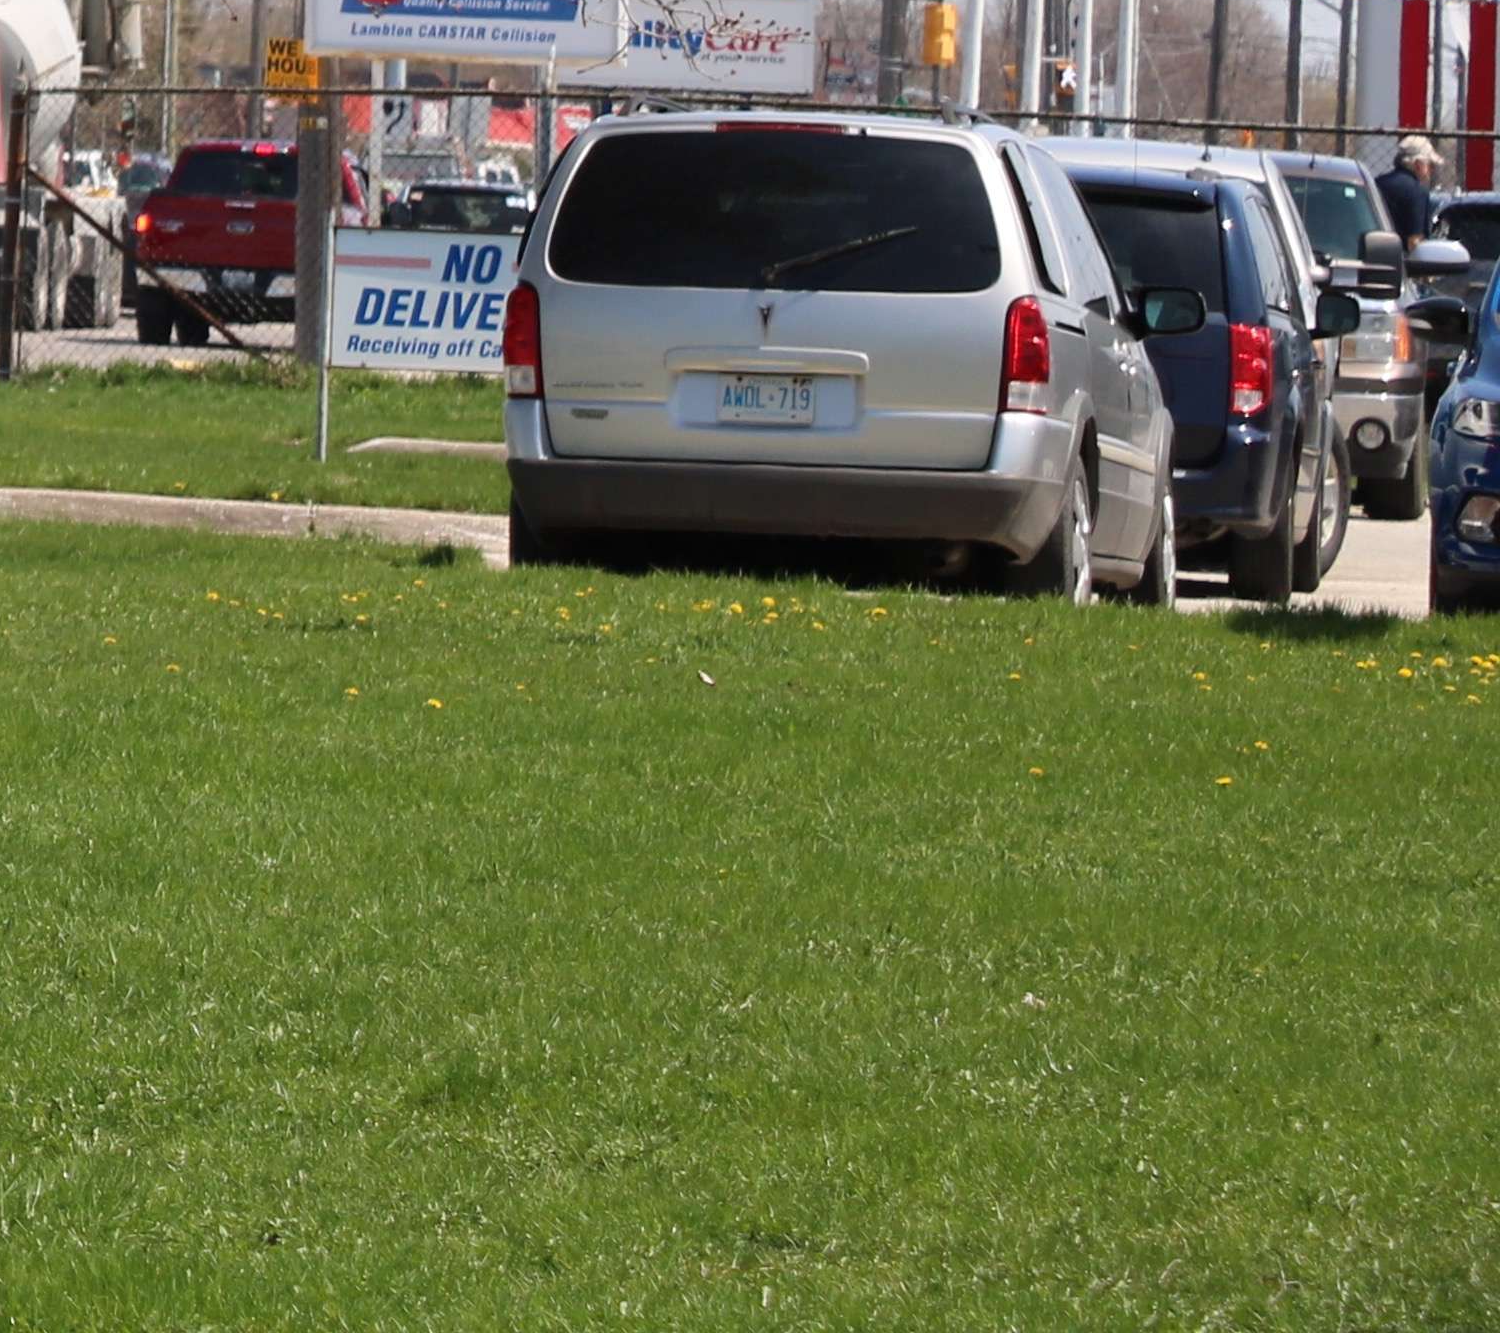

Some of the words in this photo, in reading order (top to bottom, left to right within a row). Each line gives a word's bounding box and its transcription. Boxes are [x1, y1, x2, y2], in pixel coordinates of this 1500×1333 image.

[350, 21, 413, 38] Lambton
[418, 23, 486, 41] CARSTAR
[491, 25, 557, 43] Collision
[441, 244, 503, 285] NO
[347, 335, 441, 359] Receiving
[446, 338, 475, 358] off
